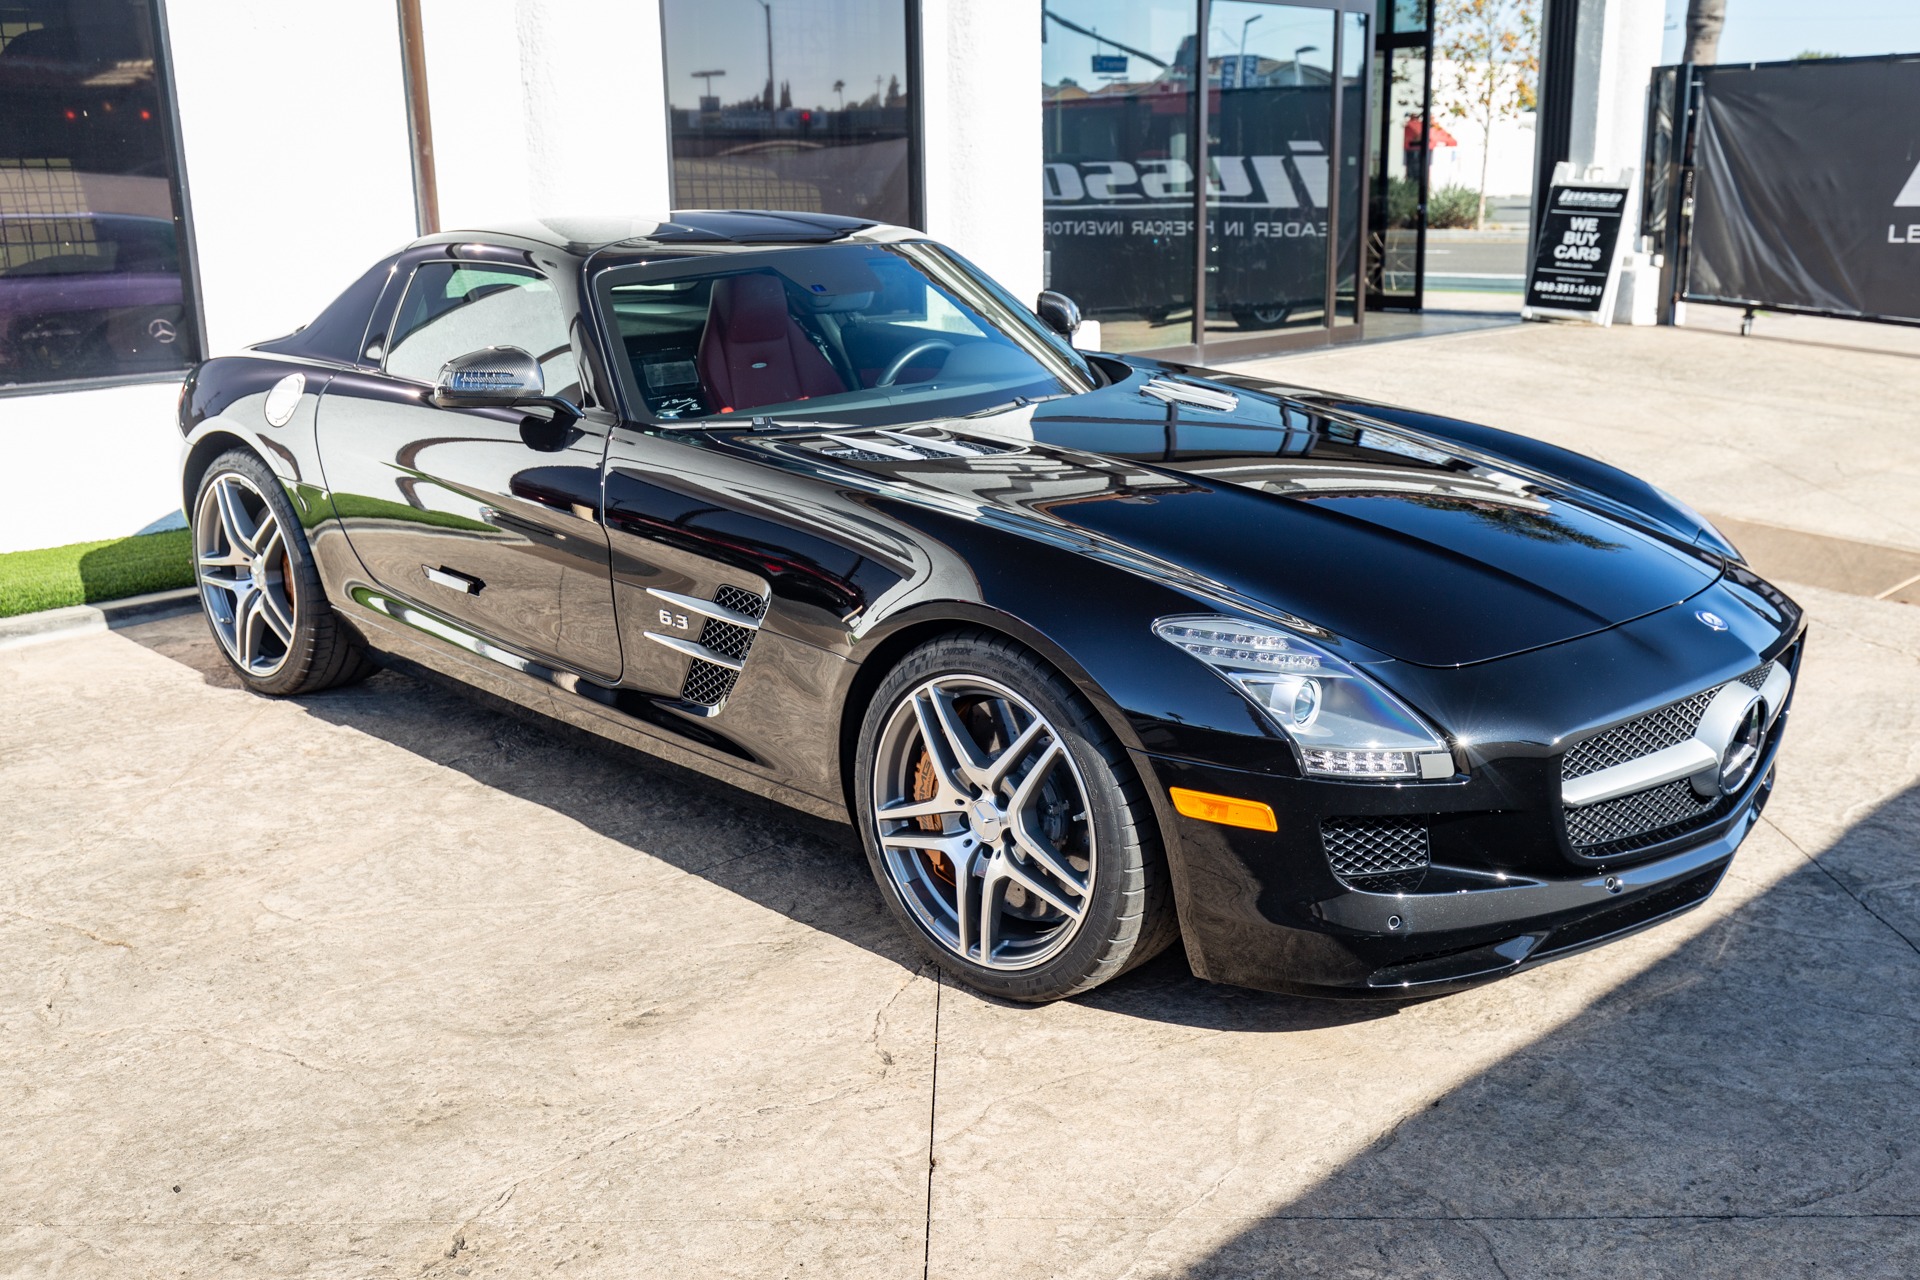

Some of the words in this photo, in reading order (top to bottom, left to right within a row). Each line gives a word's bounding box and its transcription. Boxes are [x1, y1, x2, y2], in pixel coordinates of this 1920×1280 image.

[1570, 217, 1599, 232] WE
[1562, 231, 1600, 246] BUY
[1553, 245, 1601, 262] CARS
[659, 609, 689, 629] 6.3
[919, 759, 931, 800] AMG
